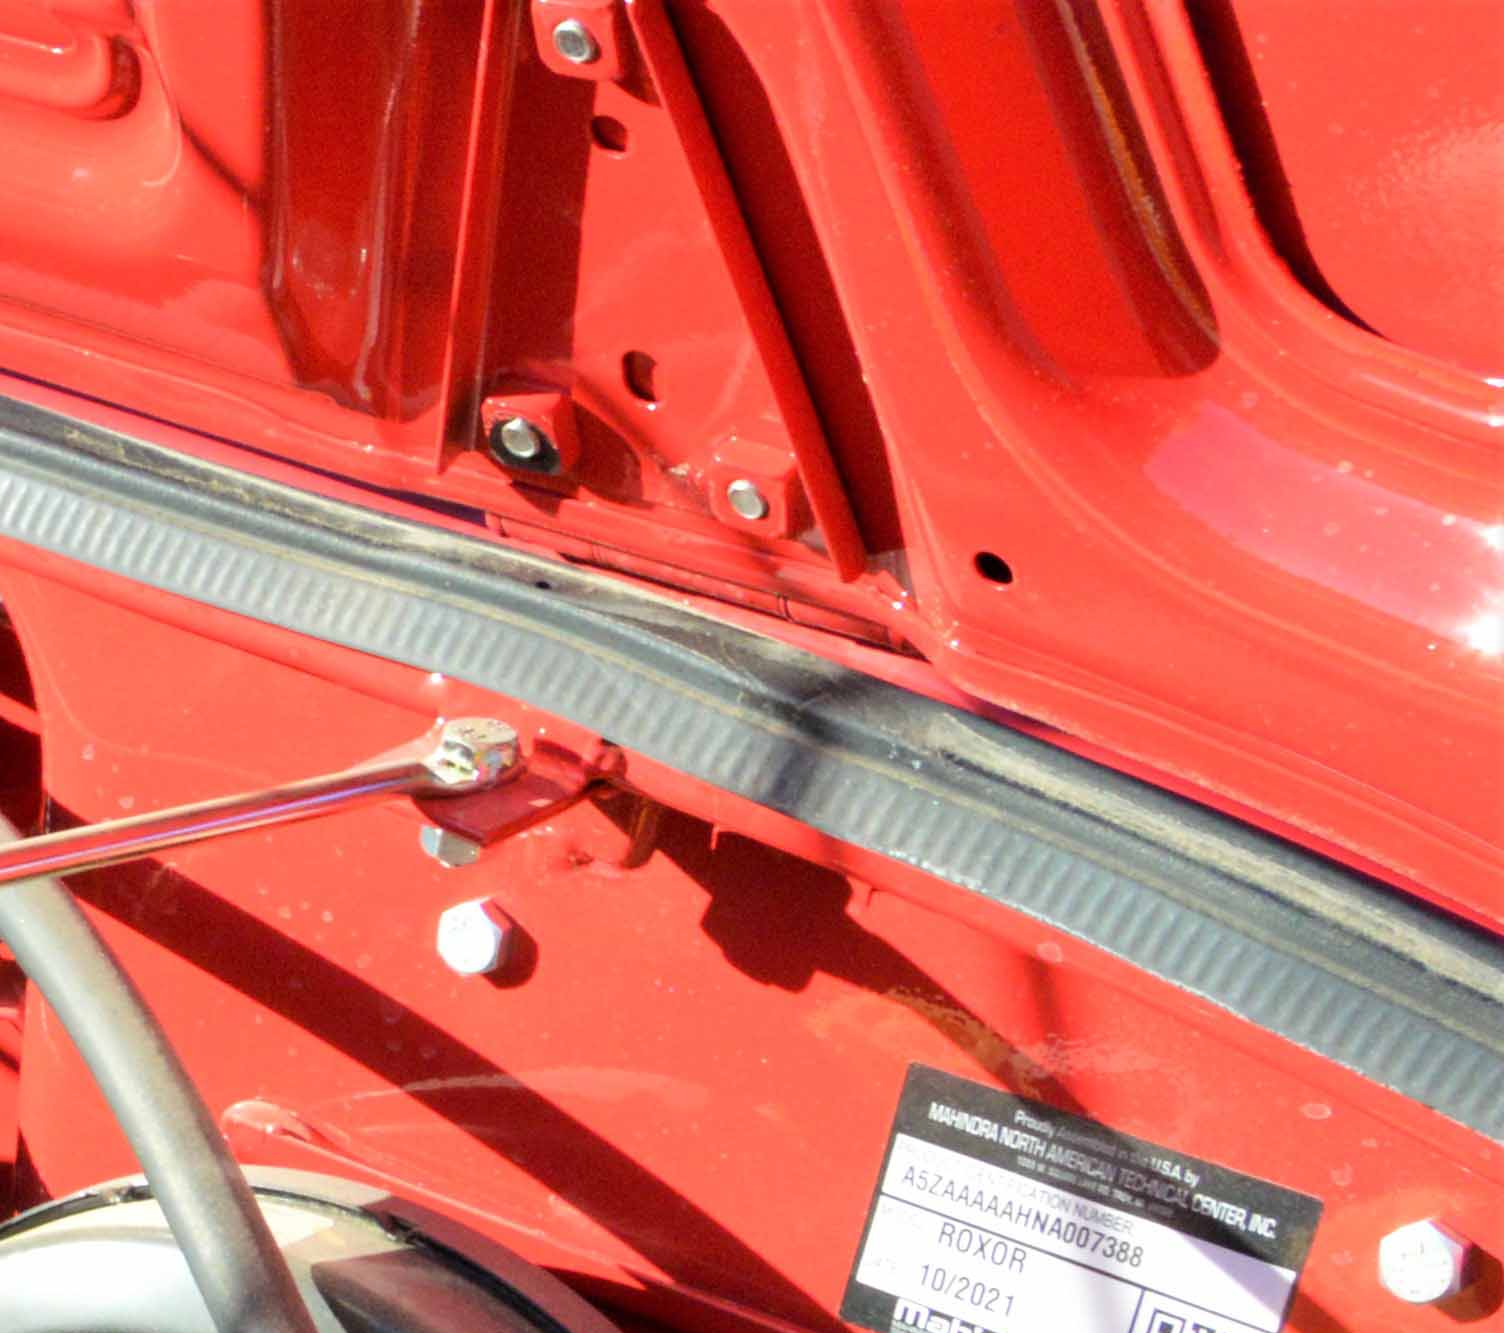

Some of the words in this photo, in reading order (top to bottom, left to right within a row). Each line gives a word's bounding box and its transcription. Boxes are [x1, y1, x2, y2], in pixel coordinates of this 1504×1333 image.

[927, 1101, 998, 1142] MAHINDRA
[999, 1123, 1046, 1155] NORTH
[1047, 1143, 1115, 1183] AMERICAN
[1118, 1167, 1190, 1208] TECHNICAL
[1248, 1212, 1278, 1239] INC.
[902, 1165, 1144, 1268] A5ZAAAAAHNA007388
[937, 1221, 1028, 1274] ROXOR
[921, 1263, 1015, 1317] 10/2021
